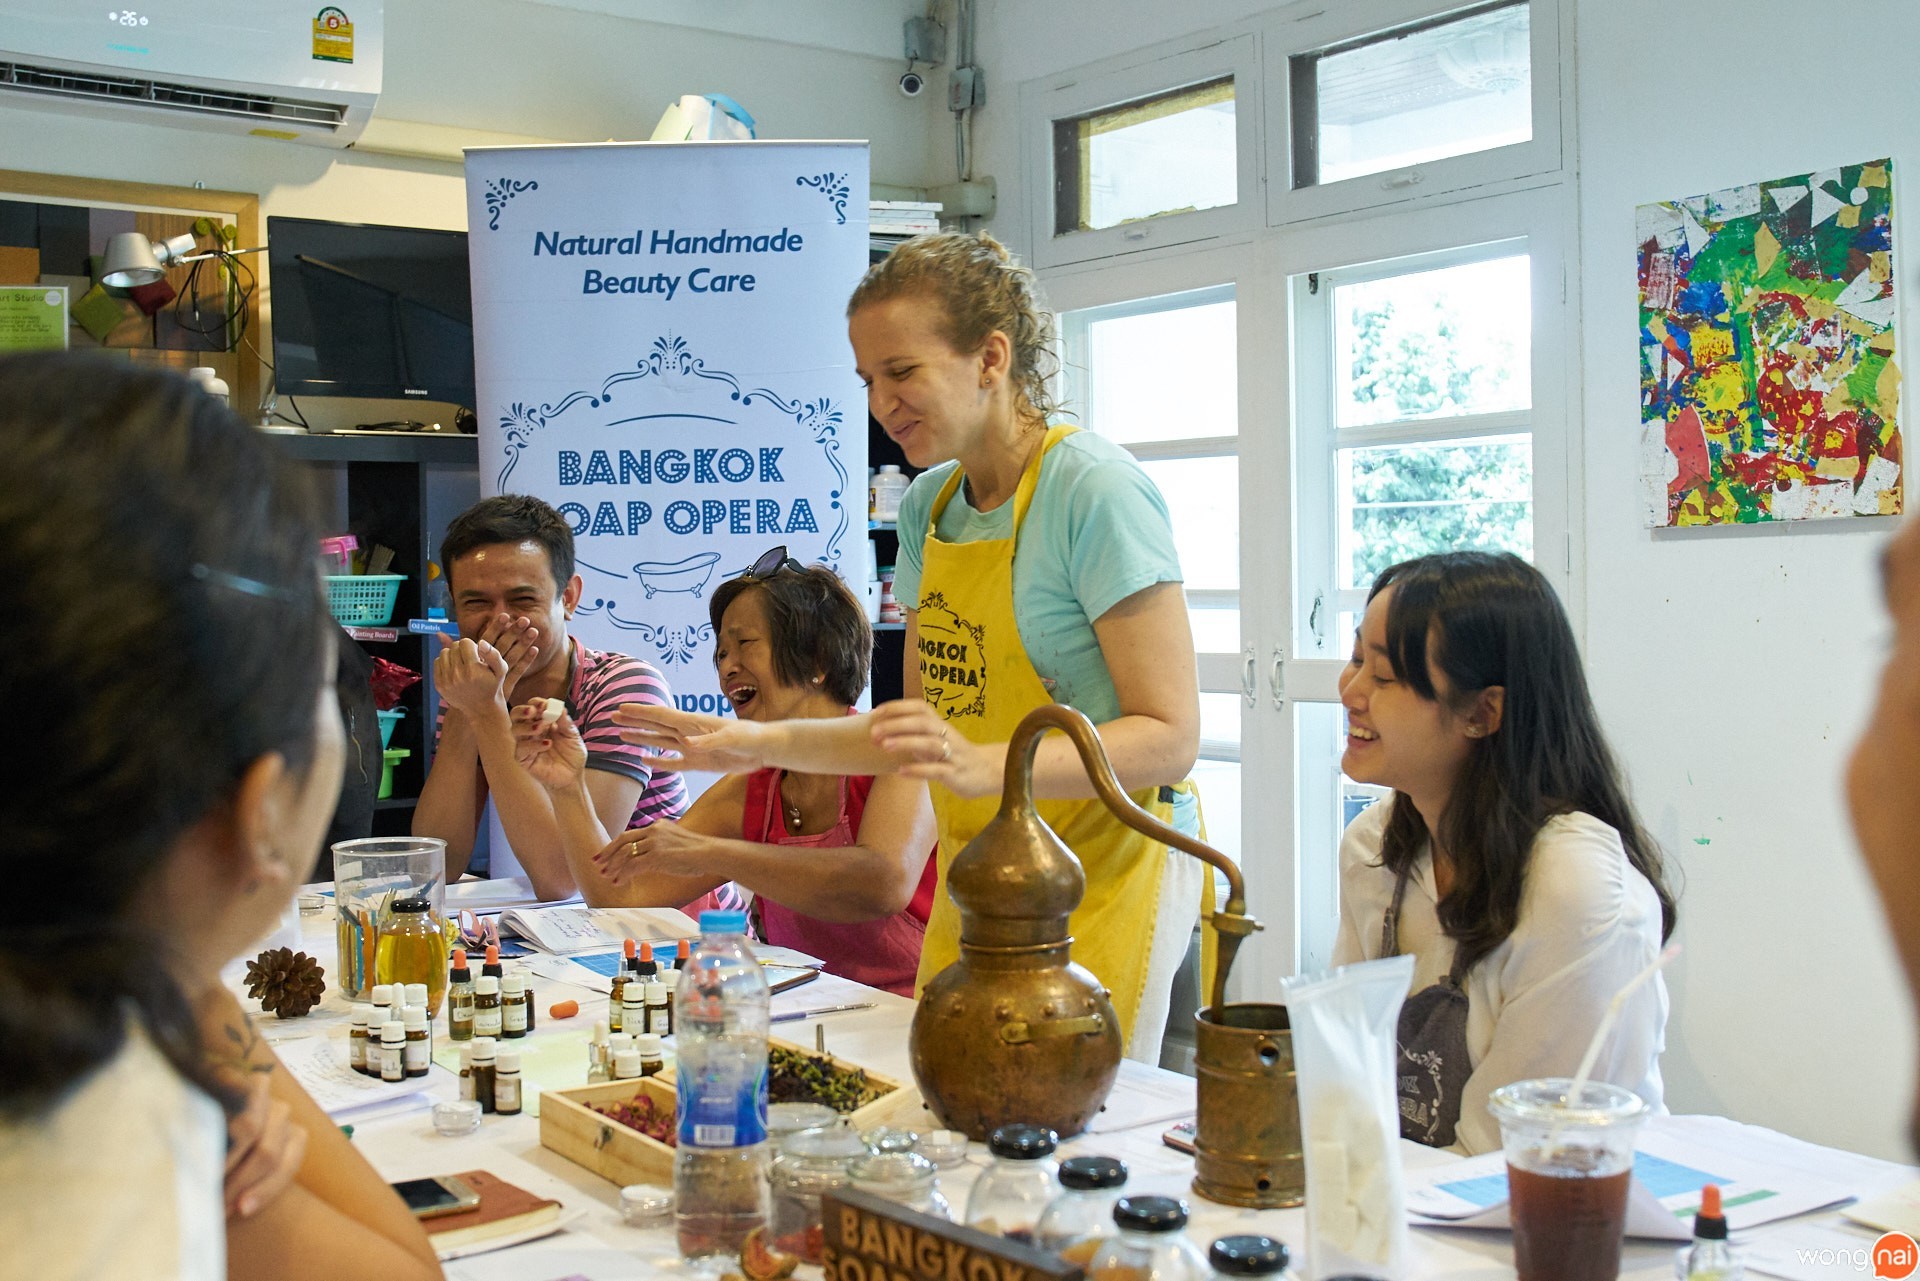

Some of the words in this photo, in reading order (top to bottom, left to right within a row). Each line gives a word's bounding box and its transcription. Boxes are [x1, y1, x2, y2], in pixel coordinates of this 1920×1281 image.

[119, 10, 138, 27] 26
[533, 229, 643, 256] Natural
[649, 227, 803, 255] Handmade
[582, 269, 682, 301] Beauty
[688, 267, 756, 293] Care
[15, 293, 45, 302] Studio
[558, 447, 785, 485] BANGKOK
[556, 501, 653, 536] OAP
[663, 498, 820, 535] OPERA
[375, 631, 395, 639] Boards
[411, 622, 420, 630] Oil
[421, 623, 441, 632] Pastels
[929, 663, 979, 688] OPERA
